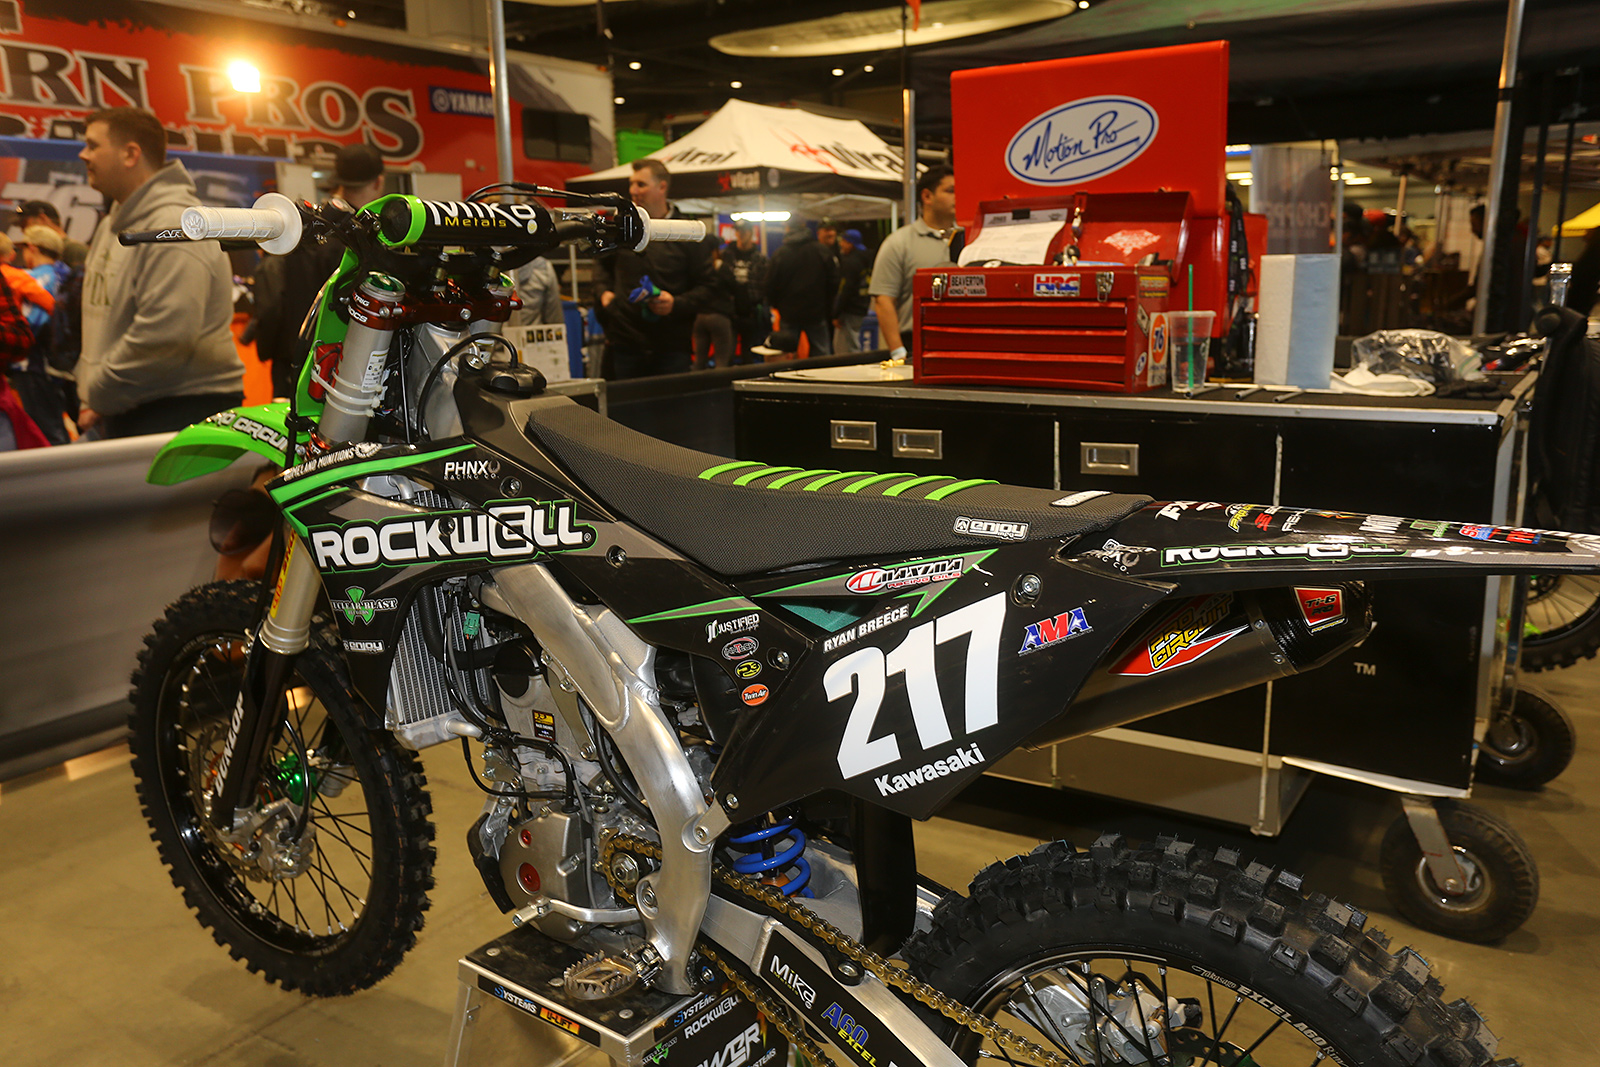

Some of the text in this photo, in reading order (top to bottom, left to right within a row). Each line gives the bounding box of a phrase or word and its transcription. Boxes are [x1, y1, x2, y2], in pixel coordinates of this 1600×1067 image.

[448, 92, 494, 116] YAMAH
[1023, 110, 1138, 171] Motion Pro
[445, 216, 507, 228] Metals
[951, 275, 985, 287] BEAVERTON
[1036, 276, 1079, 291] HRC
[1152, 323, 1165, 353] 76
[233, 416, 289, 451] CIRCUI
[317, 447, 355, 470] MUNITIONS
[445, 460, 489, 476] PHNX
[311, 504, 584, 569] ROCKWELL
[969, 520, 1027, 538] enjoy
[888, 572, 962, 589] RACING OILS
[363, 599, 397, 610] BLAST
[1311, 604, 1335, 616] PRO
[718, 613, 760, 634] JUSTIFIED
[824, 605, 910, 652] RYAN BREECE
[1018, 606, 1093, 654] AMA
[1150, 608, 1195, 653] PRO
[1152, 597, 1231, 668] CIRCUIT
[1353, 661, 1376, 676] TM
[744, 688, 768, 701] Twin Air
[823, 591, 1006, 781] 217
[215, 690, 244, 798] DUNLOP
[874, 743, 986, 797] Kawasaki
[494, 985, 538, 1014] SYSTEMS
[1192, 965, 1237, 989] Takasago
[1237, 985, 1293, 1023] EXCEL
[1293, 1022, 1327, 1047] A60
[821, 1001, 870, 1047] A60
[837, 1027, 878, 1067] EXCEL
